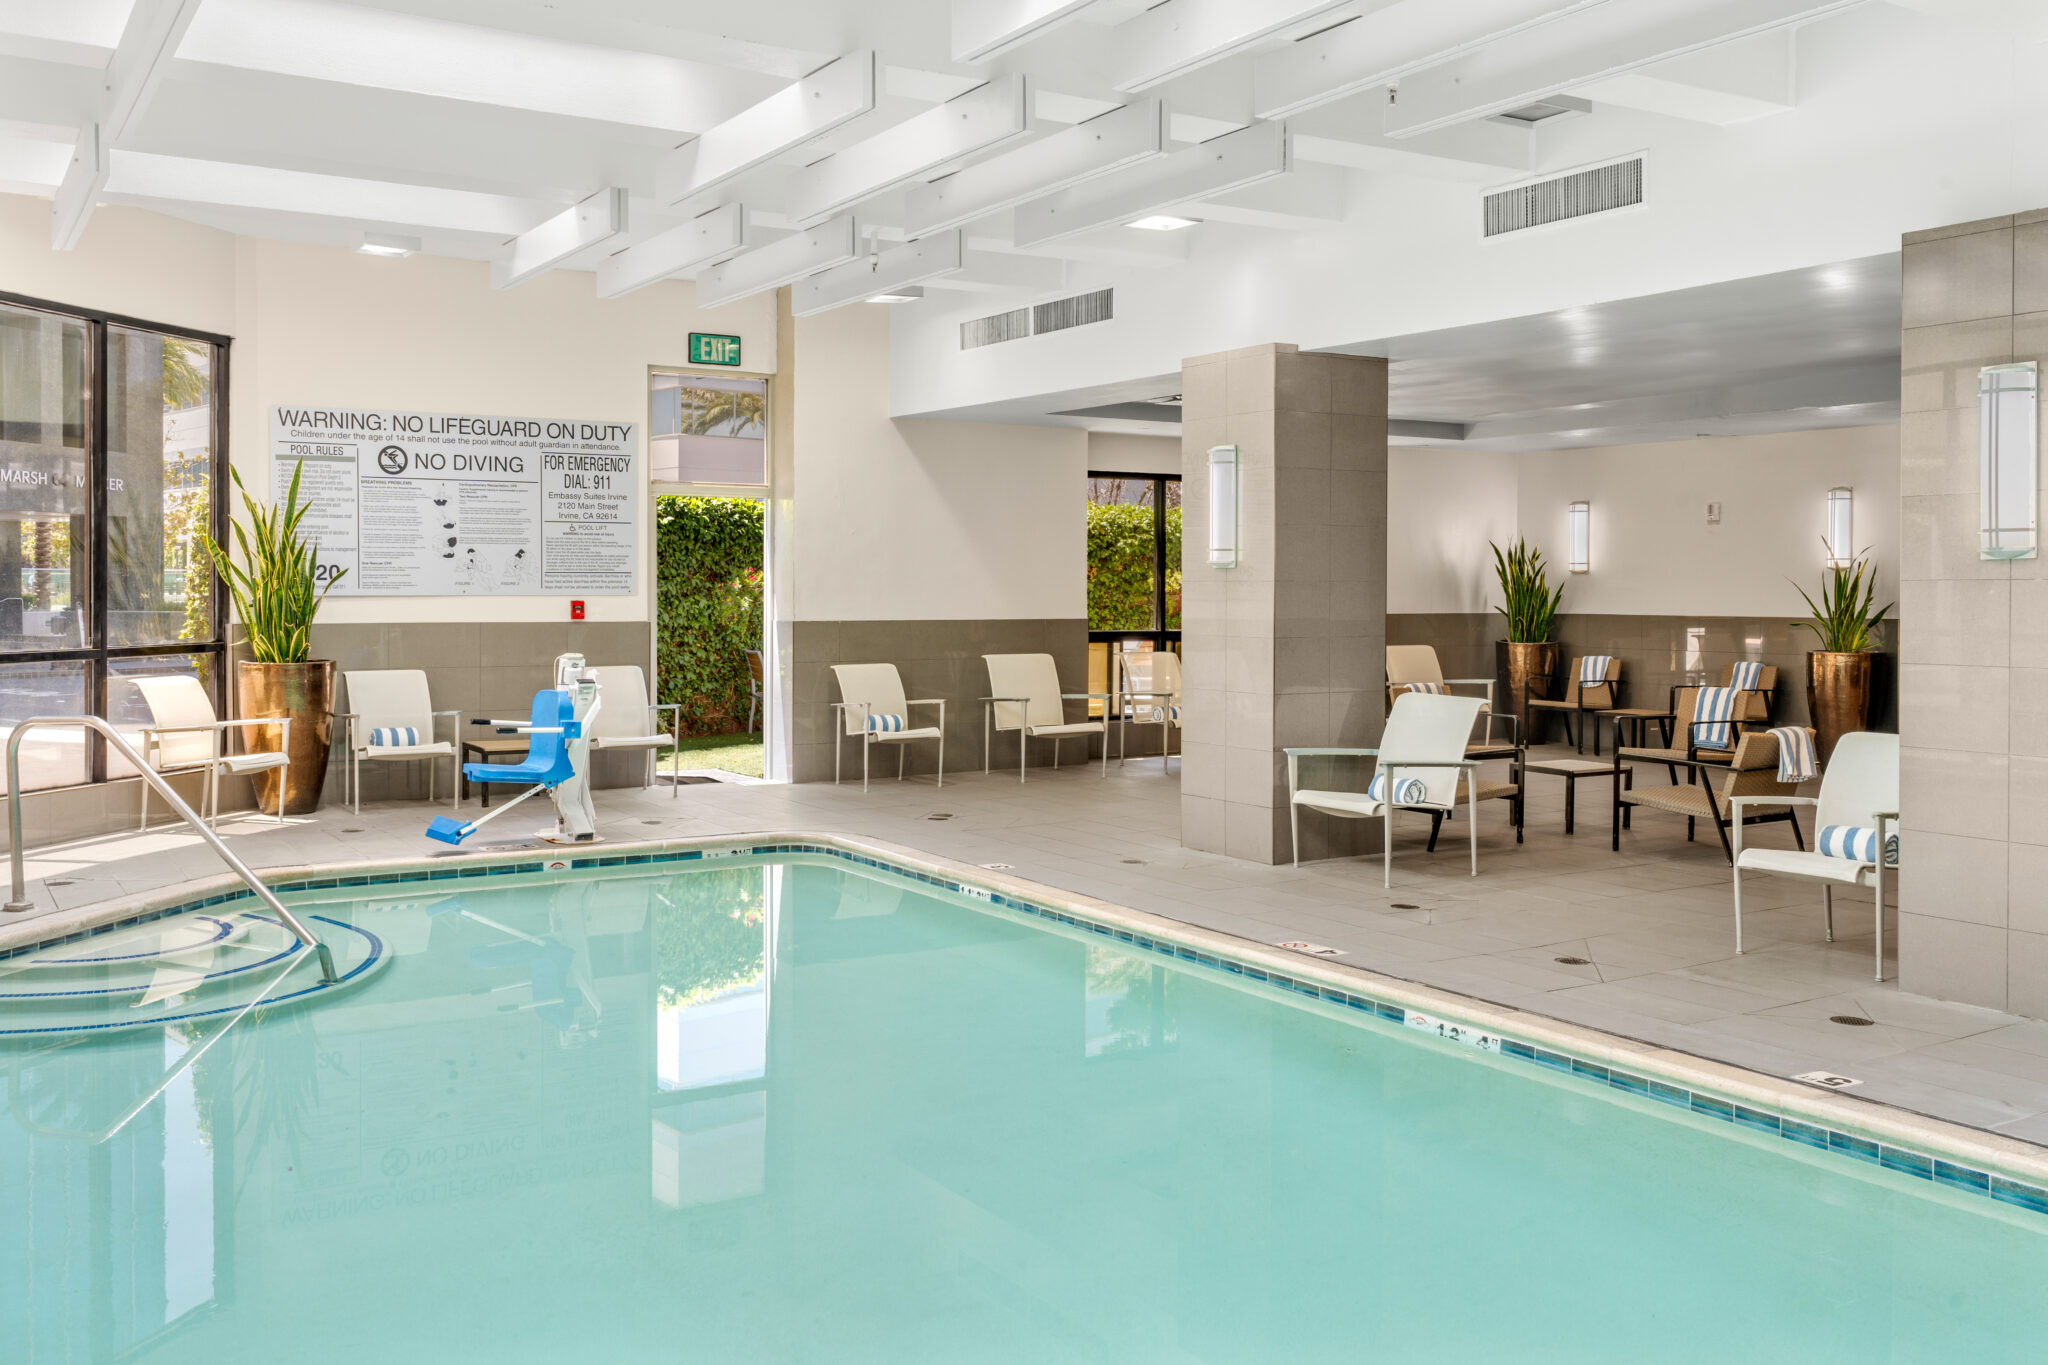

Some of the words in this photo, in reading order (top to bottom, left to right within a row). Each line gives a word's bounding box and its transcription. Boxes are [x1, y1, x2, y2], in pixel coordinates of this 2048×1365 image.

[701, 337, 731, 362] EXIT
[278, 408, 387, 431] WARNING:
[393, 415, 424, 433] NO
[430, 417, 541, 438] LIFEGUARD
[547, 423, 575, 440] ON
[581, 424, 632, 442] DUTY
[290, 430, 325, 438] Children
[353, 432, 366, 440] the
[396, 434, 405, 442] 14
[407, 435, 426, 443] shall
[472, 438, 488, 447] pool
[490, 439, 517, 447] without
[539, 441, 570, 449] guardian
[580, 442, 621, 450] attendance.
[290, 445, 314, 455] POOL
[316, 446, 344, 456] RULES
[415, 453, 446, 470] NO
[453, 455, 524, 473] DIVING
[544, 455, 564, 470] FOR
[568, 456, 631, 473] EMERGENCY
[0, 469, 48, 485] MARSH
[564, 473, 590, 489] DIAL:
[593, 475, 611, 490] 911
[548, 491, 581, 501] Embassy
[557, 502, 576, 510] 2120
[558, 512, 580, 520] Irvine,
